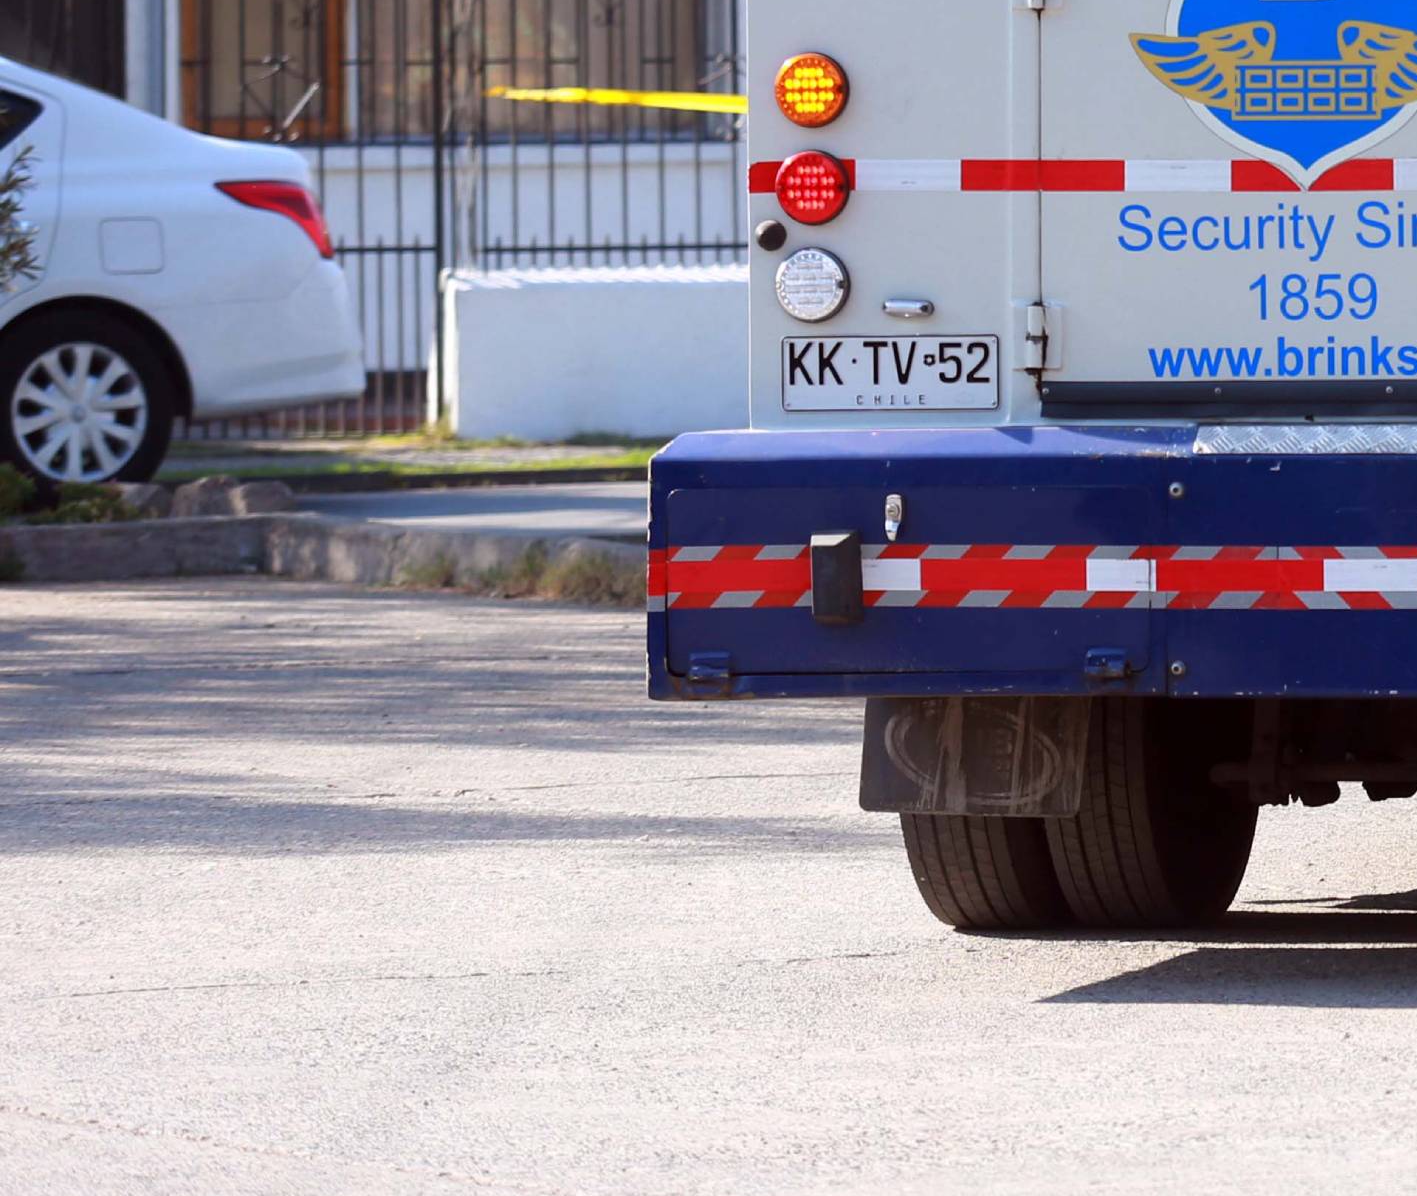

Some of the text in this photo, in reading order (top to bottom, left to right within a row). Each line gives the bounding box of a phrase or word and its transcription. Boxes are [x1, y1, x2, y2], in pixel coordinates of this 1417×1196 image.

[1117, 203, 1335, 261] Security
[1249, 273, 1378, 320] 1859
[856, 395, 926, 405] CHILE
